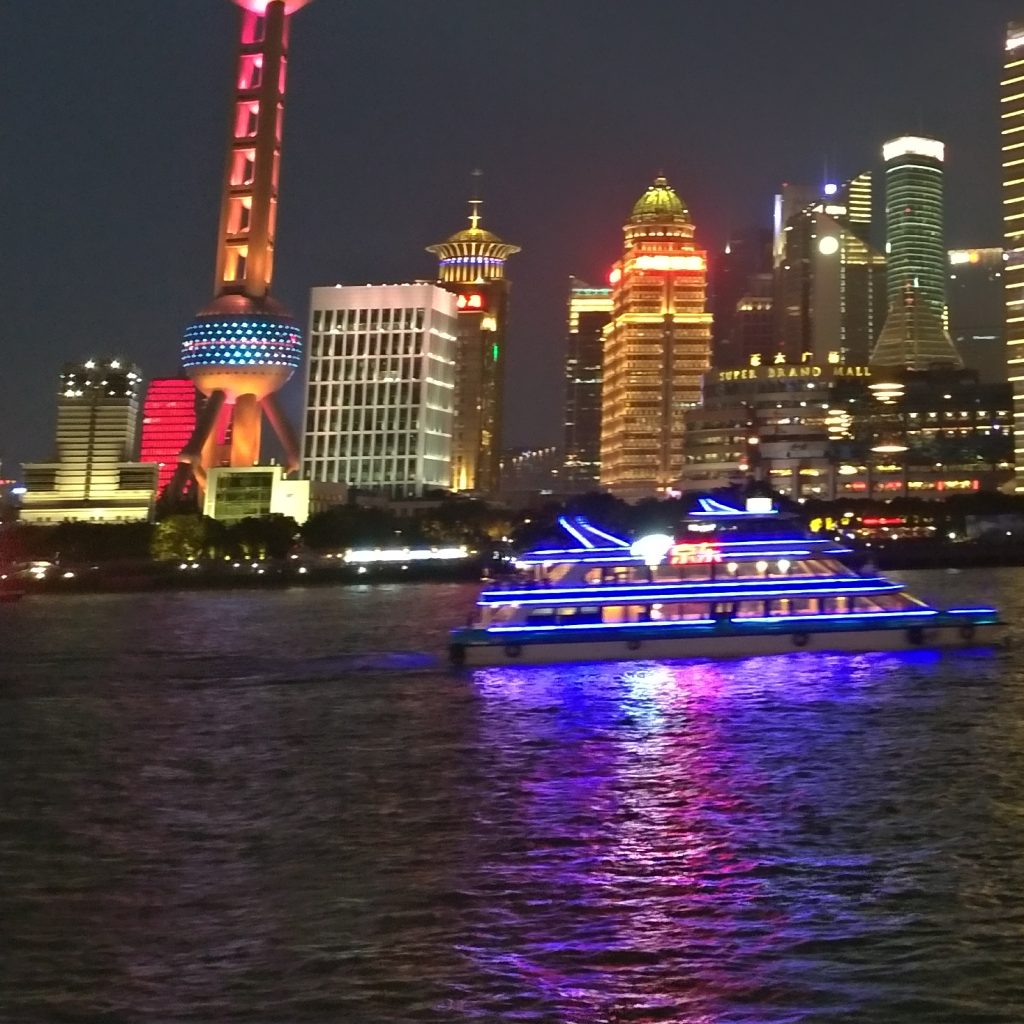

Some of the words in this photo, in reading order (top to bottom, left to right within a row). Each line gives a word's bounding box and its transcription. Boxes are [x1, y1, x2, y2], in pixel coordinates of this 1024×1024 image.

[719, 368, 758, 382] SUPER
[767, 366, 822, 379] BRAND
[833, 365, 872, 378] MALL
